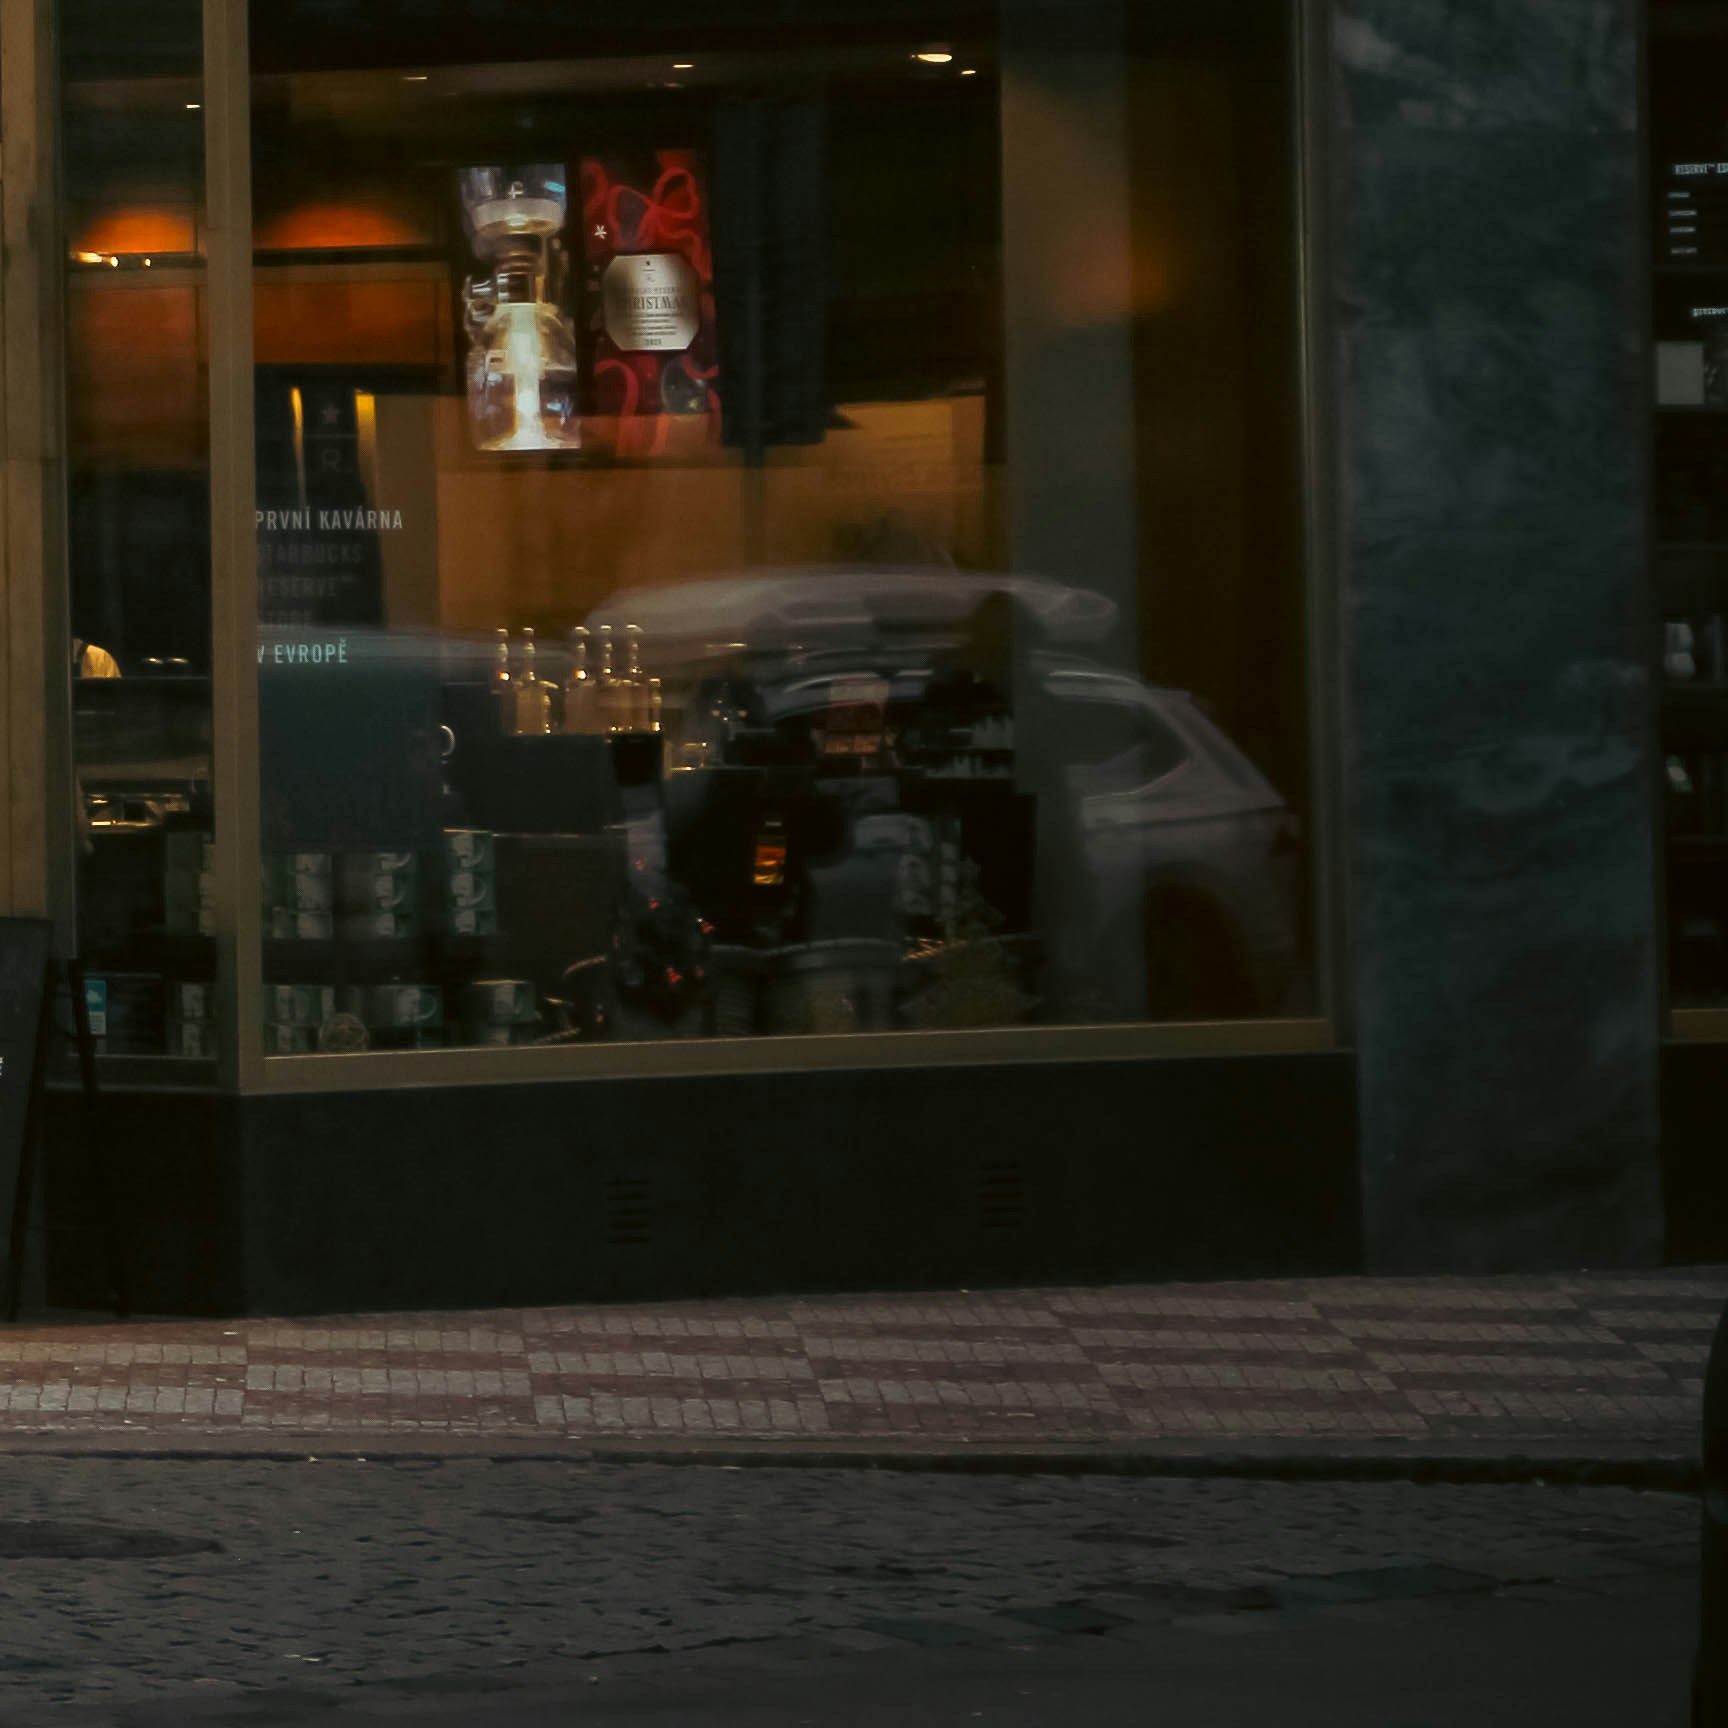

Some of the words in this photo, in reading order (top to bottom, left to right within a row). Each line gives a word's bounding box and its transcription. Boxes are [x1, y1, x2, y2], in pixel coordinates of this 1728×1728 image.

[255, 505, 312, 531] PRVNÍ
[319, 505, 404, 531] KAVÁRNA
[274, 636, 348, 664] EVROPĚ
